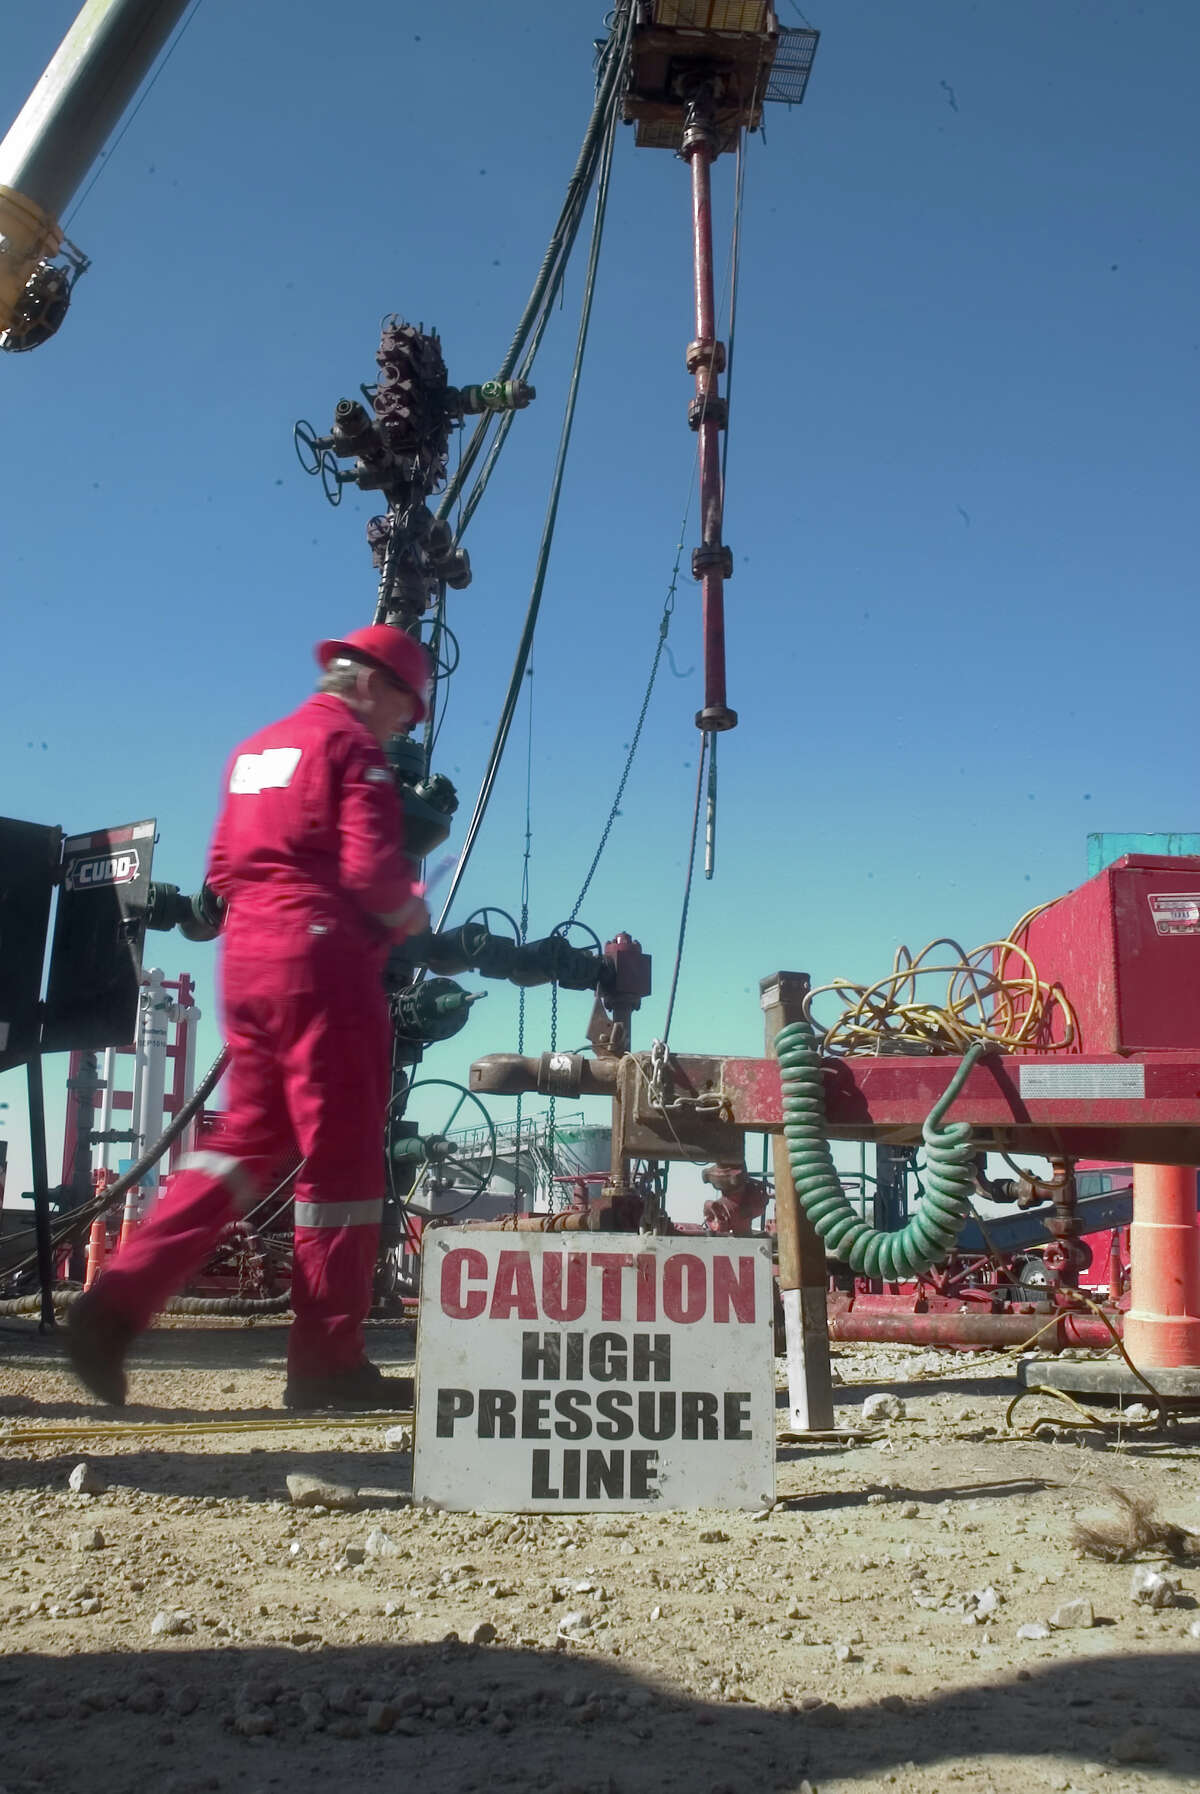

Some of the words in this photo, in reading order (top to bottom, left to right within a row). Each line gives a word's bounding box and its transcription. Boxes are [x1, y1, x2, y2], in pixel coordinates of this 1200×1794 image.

[80, 857, 131, 883] CUDD
[440, 1248, 756, 1324] CAUTION
[521, 1331, 671, 1382] HIGH
[436, 1388, 753, 1441] PRESSURE
[531, 1448, 660, 1499] LINE
